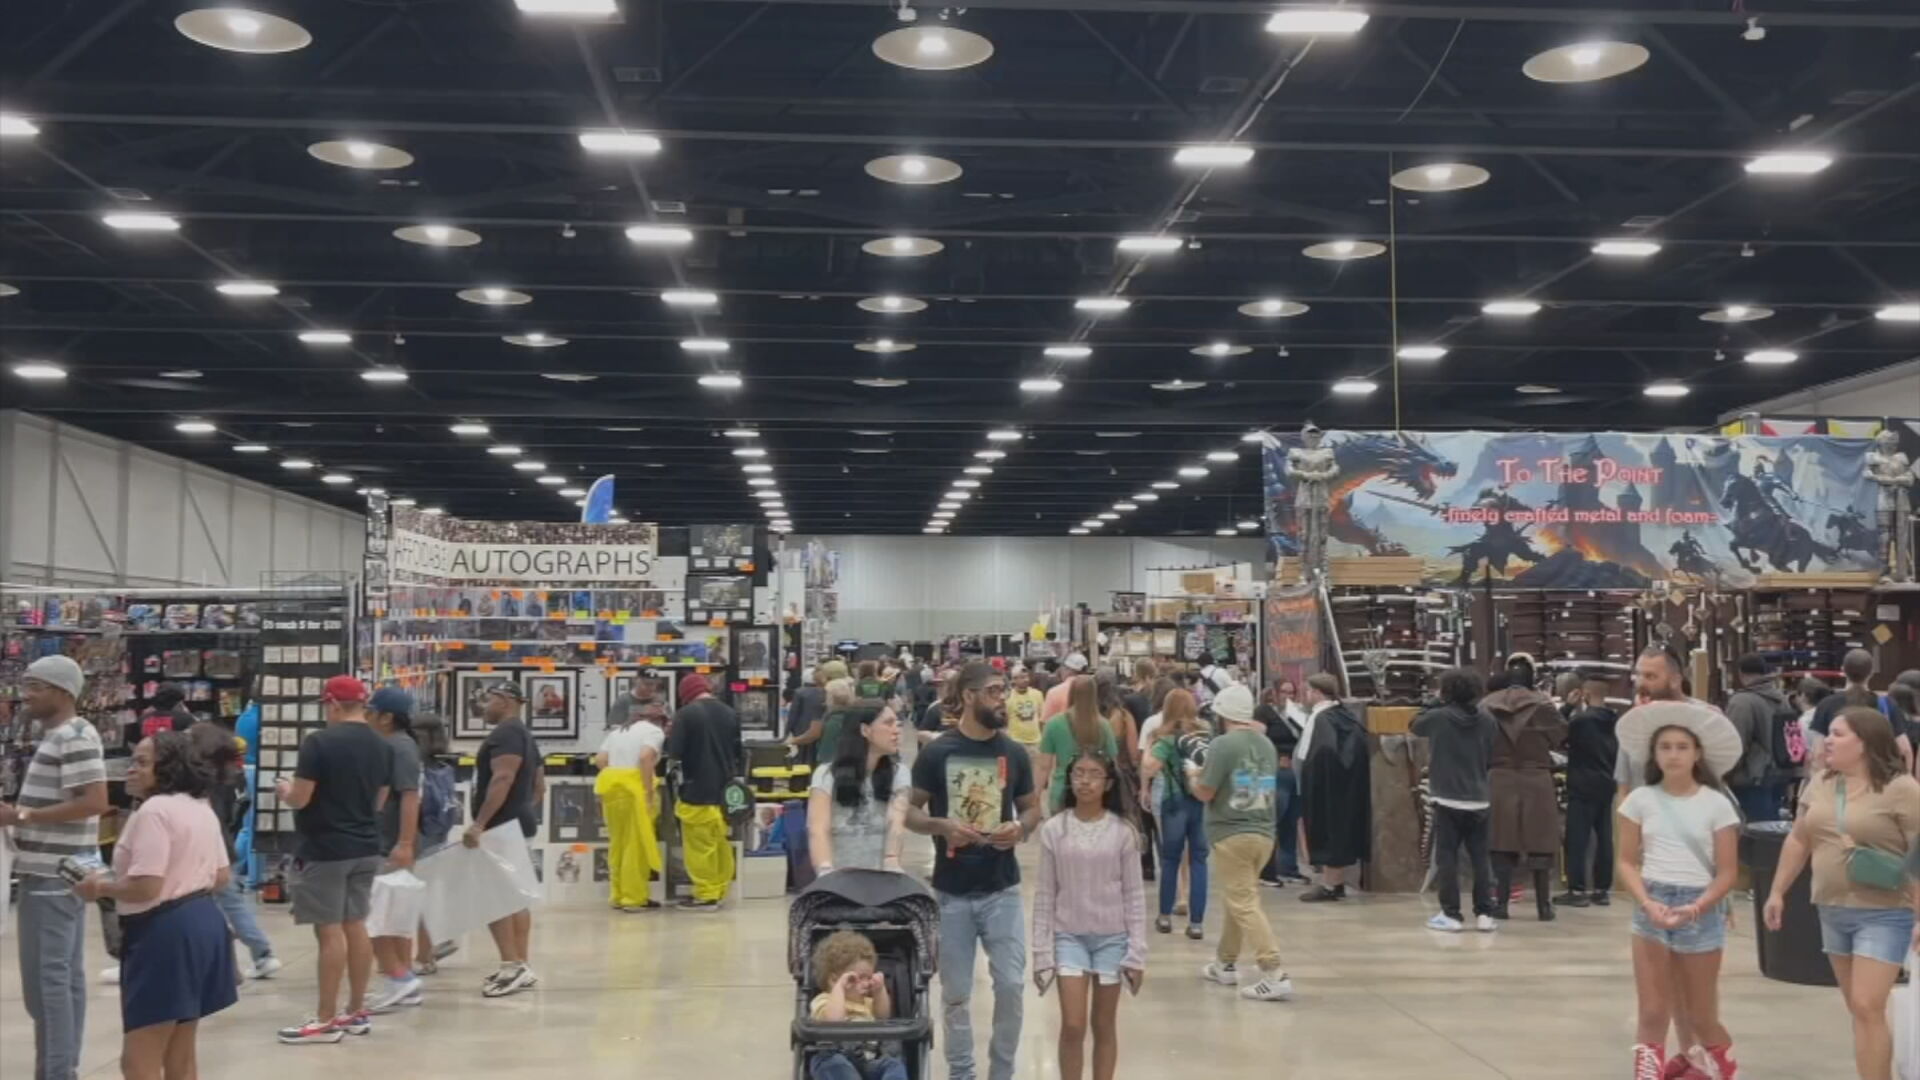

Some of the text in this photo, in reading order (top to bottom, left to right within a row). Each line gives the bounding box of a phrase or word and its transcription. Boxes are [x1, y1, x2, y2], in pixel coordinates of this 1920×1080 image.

[1495, 458, 1531, 485] To
[1503, 507, 1569, 522] crafted
[1574, 508, 1621, 523] metal
[1626, 508, 1660, 522] and
[451, 549, 650, 575] AUTOGRAPHS
